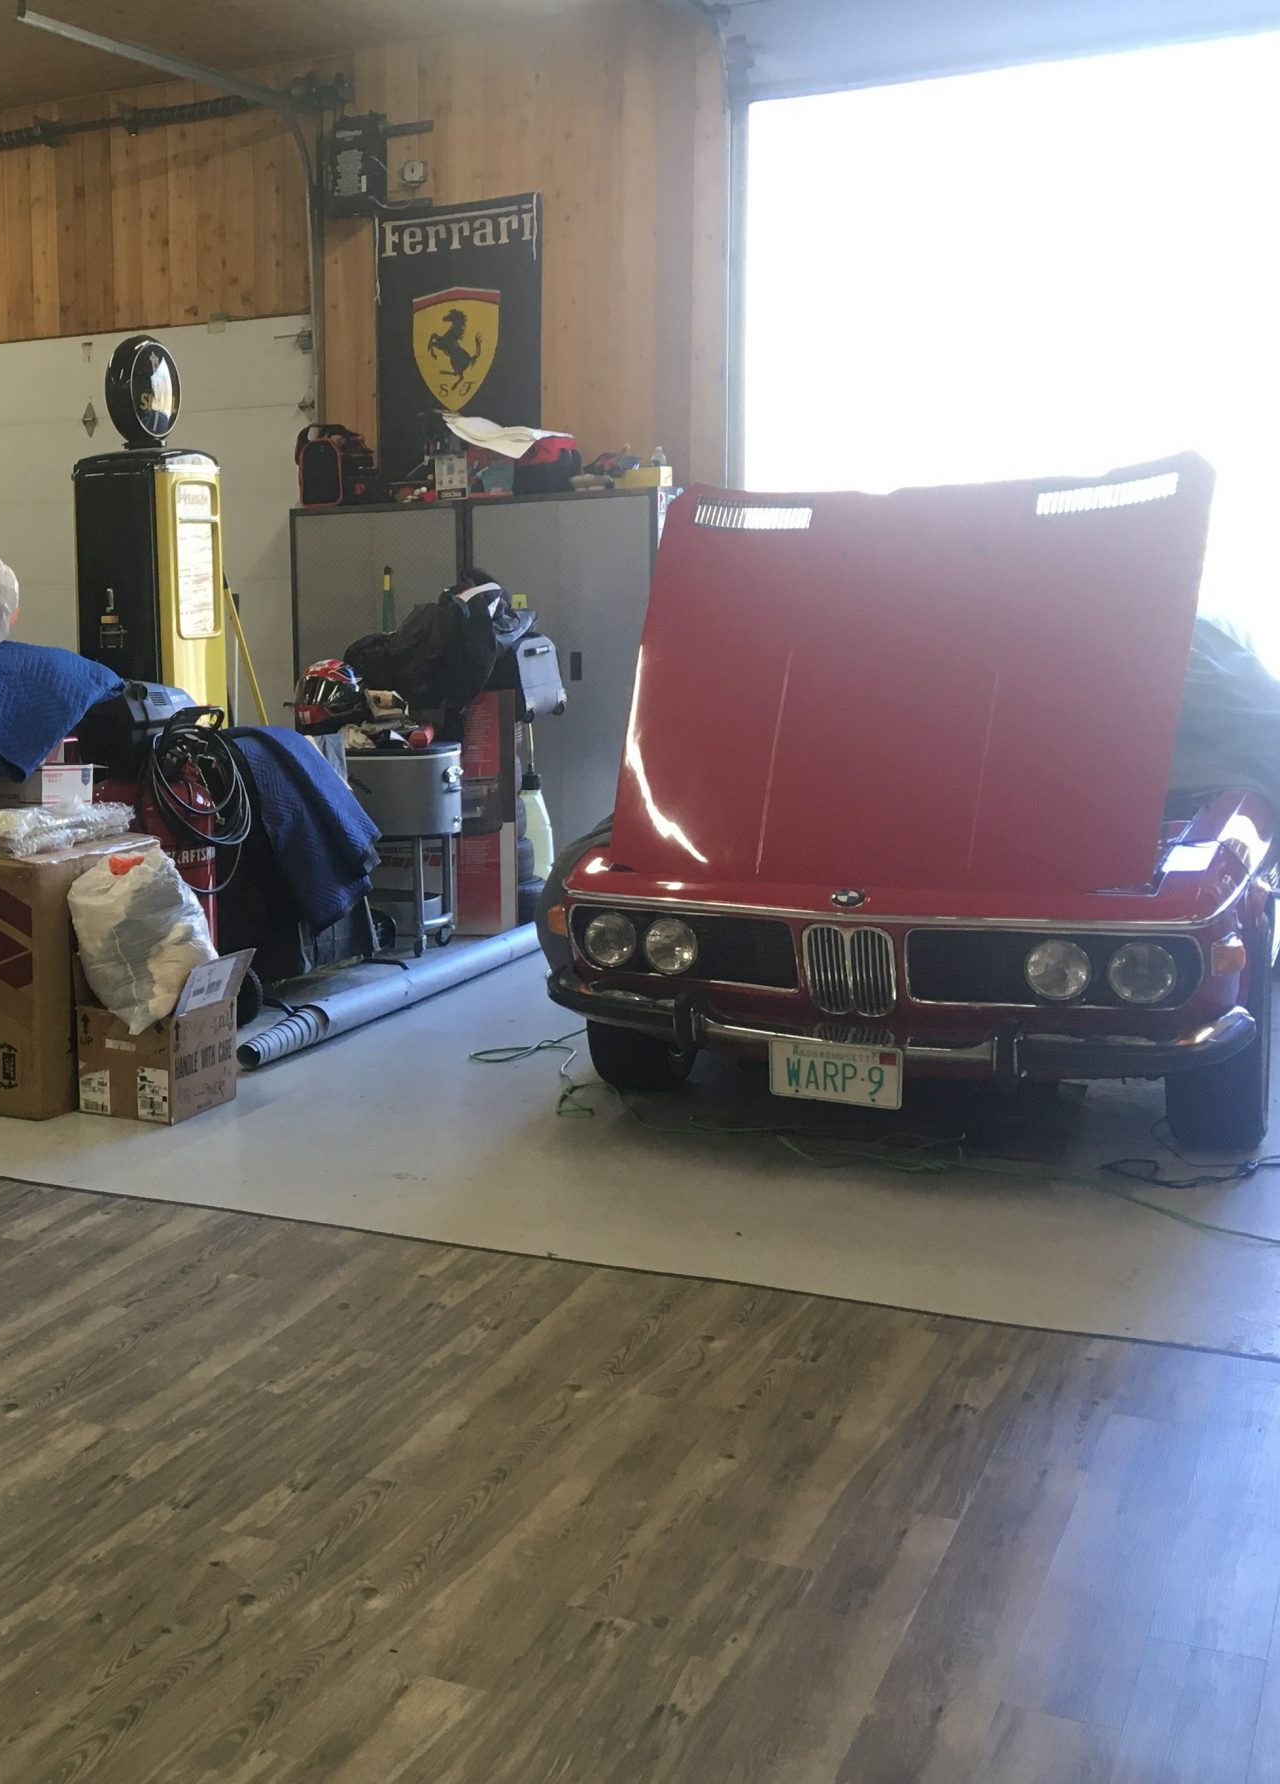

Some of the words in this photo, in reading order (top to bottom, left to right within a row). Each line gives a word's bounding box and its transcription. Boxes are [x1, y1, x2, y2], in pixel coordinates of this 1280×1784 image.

[381, 204, 534, 257] Ferrari
[80, 1035, 94, 1046] UP
[175, 1051, 198, 1081] HANDLE
